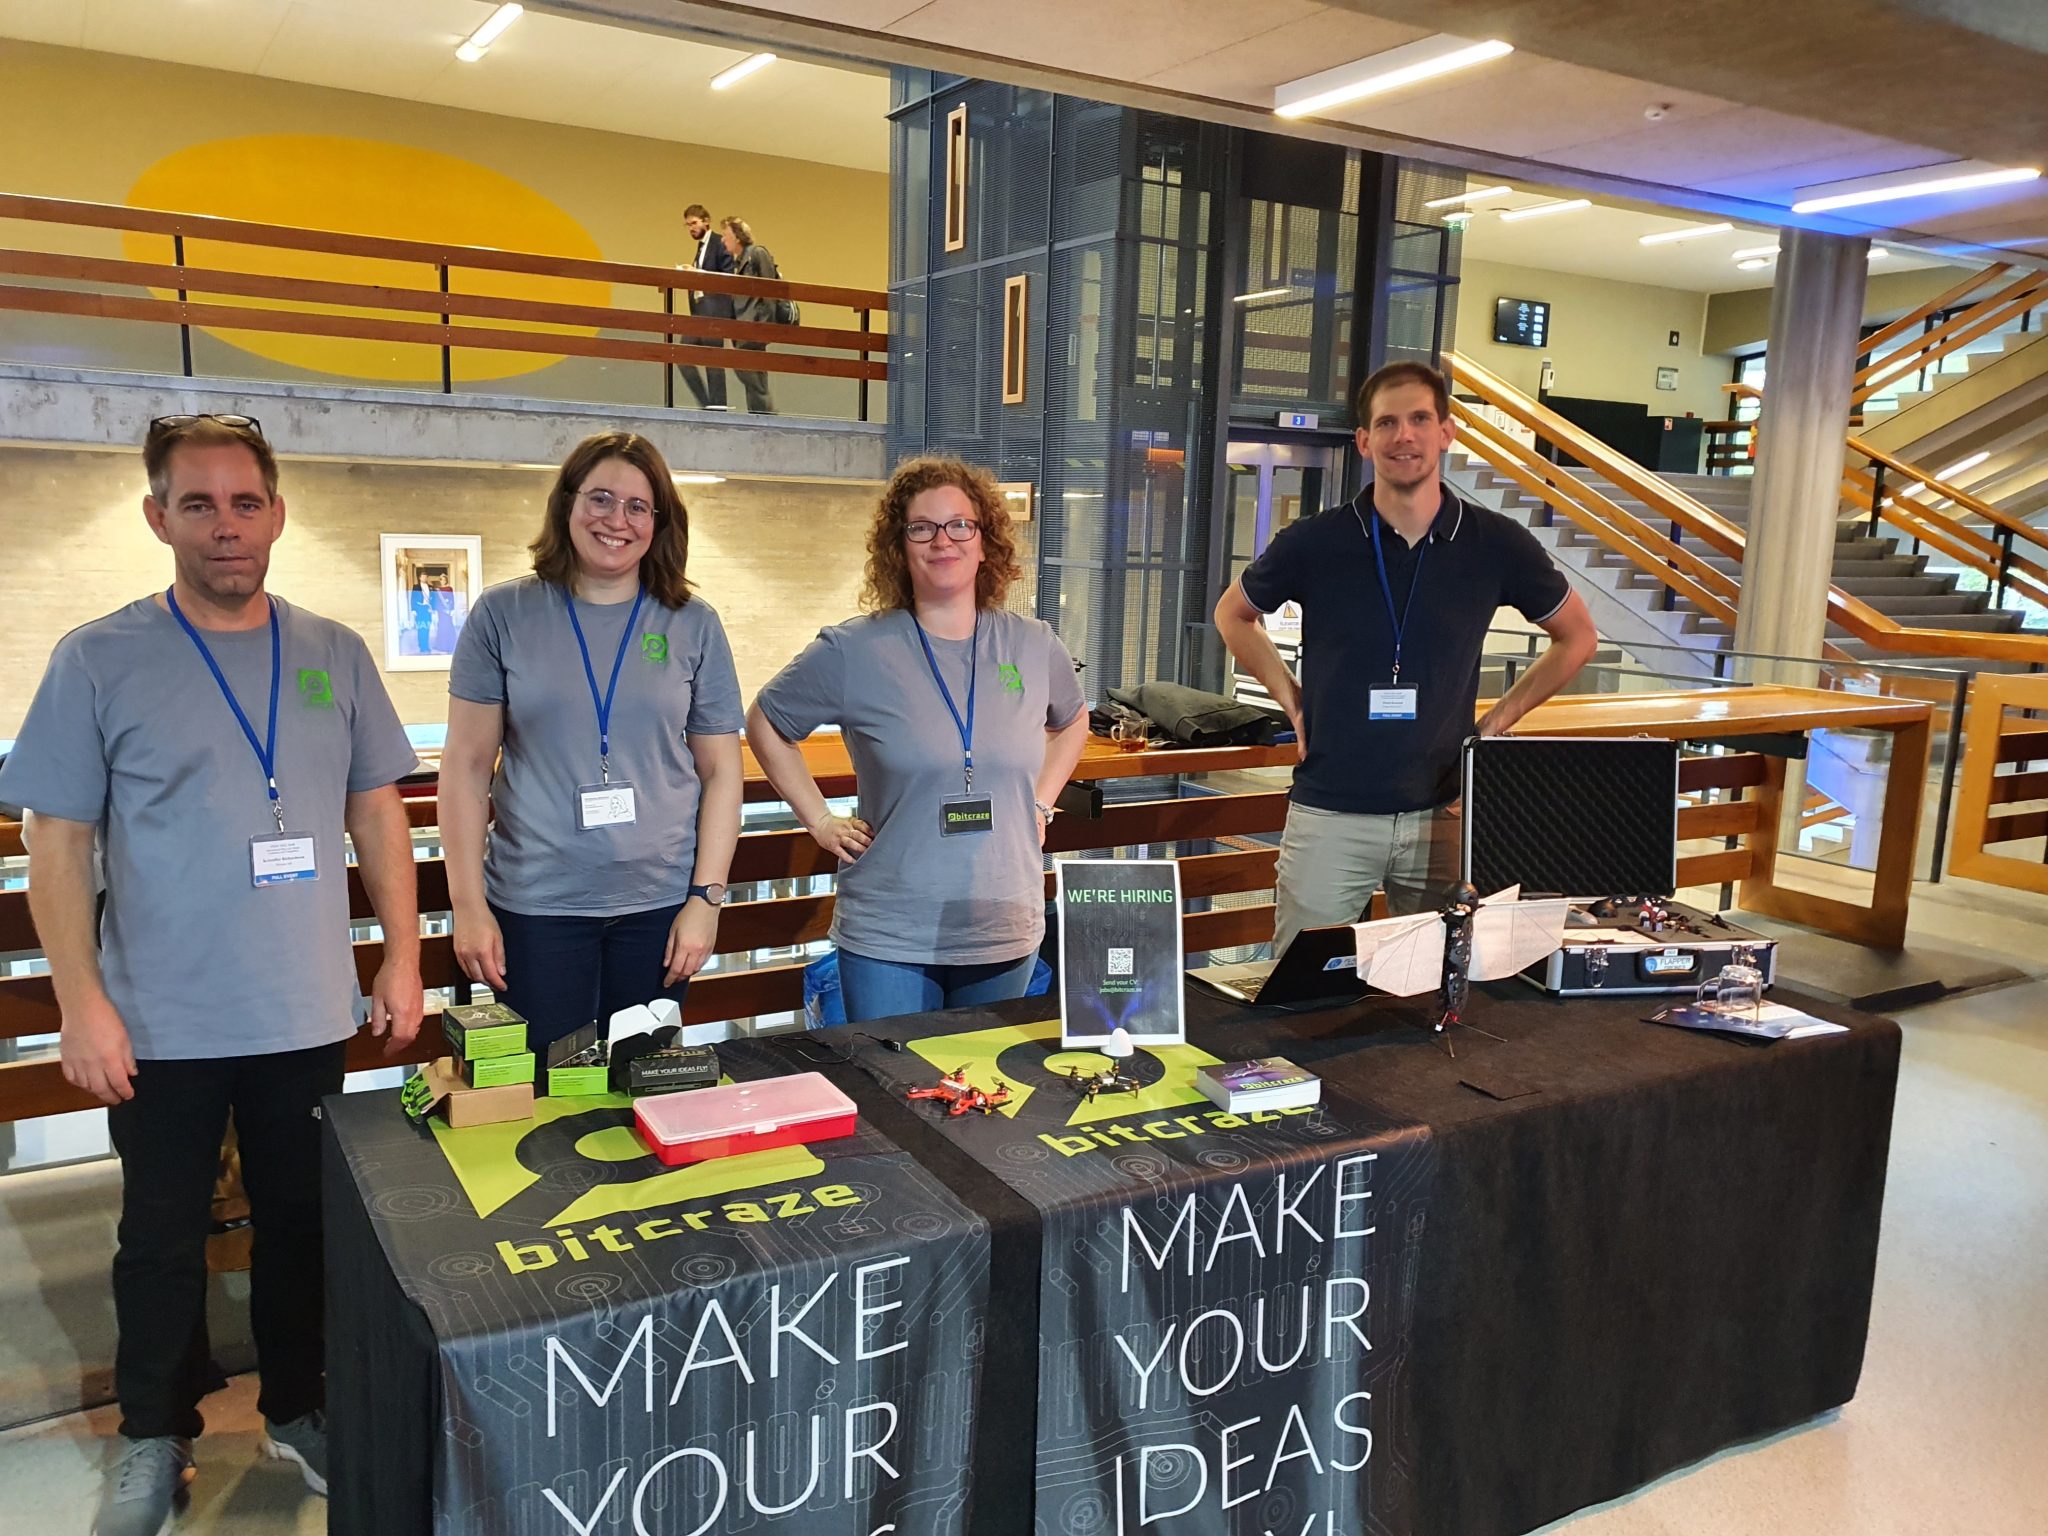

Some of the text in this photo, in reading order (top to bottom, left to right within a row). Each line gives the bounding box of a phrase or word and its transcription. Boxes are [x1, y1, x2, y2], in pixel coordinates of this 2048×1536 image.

[956, 812, 990, 820] bitcraze
[1067, 889, 1173, 903] WE'RE HIRING
[1660, 957, 1691, 966] FLAPPER
[494, 1183, 863, 1275] bitcraze
[1121, 1153, 1378, 1294] MAKE
[546, 1256, 911, 1438] MAKE
[1113, 1277, 1373, 1410] YOUR
[540, 1401, 901, 1536] YOUR
[1115, 1391, 1374, 1536] IDEAS
